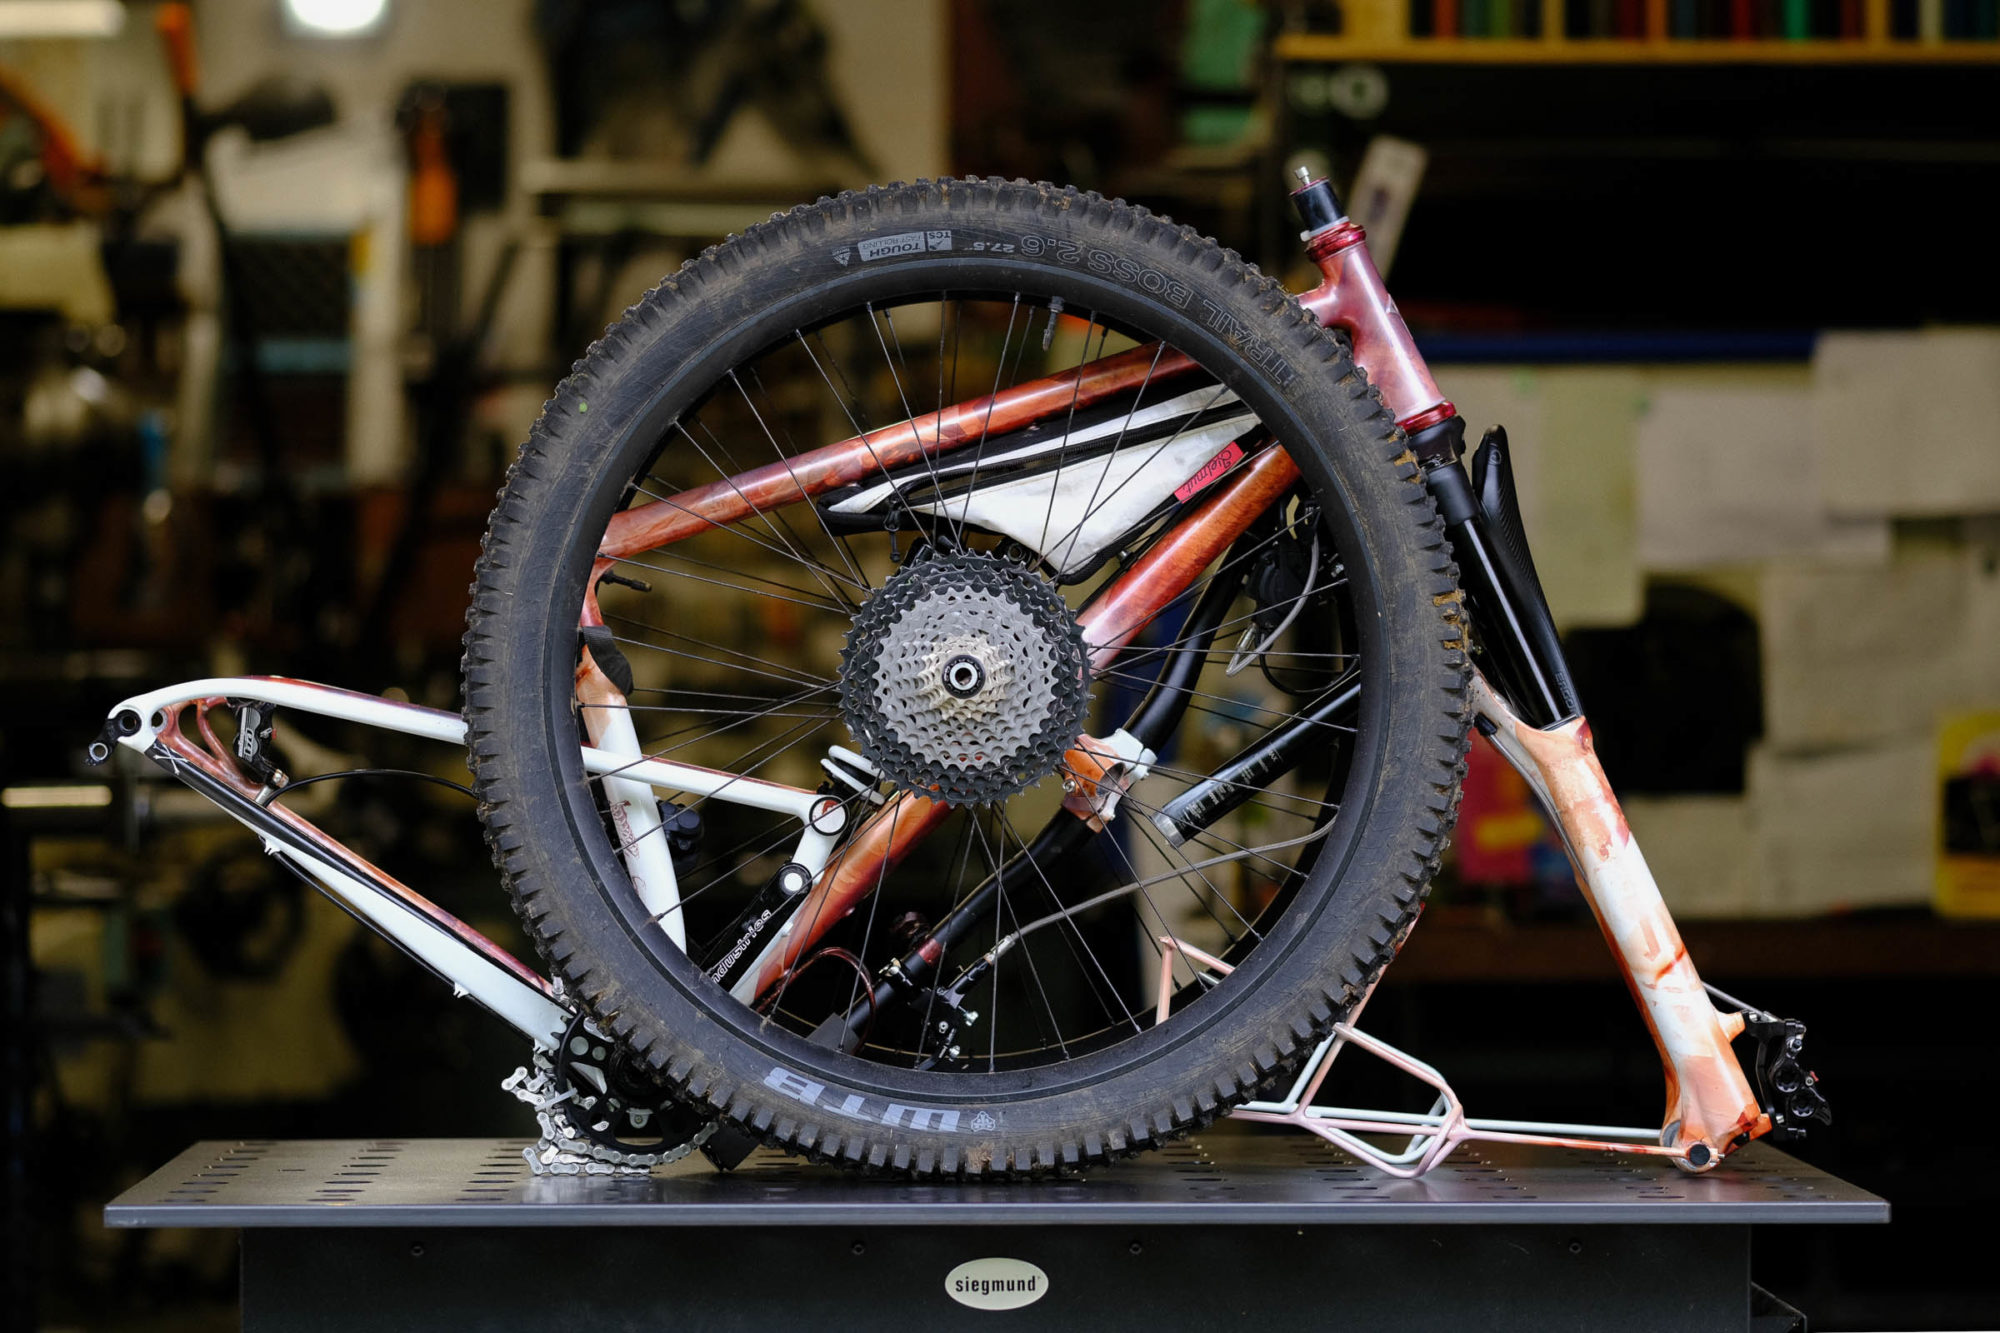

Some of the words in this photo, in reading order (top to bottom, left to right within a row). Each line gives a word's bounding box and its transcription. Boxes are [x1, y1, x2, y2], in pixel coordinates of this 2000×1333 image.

[862, 238, 898, 249] ROLLING
[869, 242, 921, 257] TOUGH
[928, 231, 951, 240] TCS
[1021, 235, 1083, 263] 2.6
[1087, 249, 1194, 309] BOSS
[1202, 299, 1289, 384] TRAIL
[711, 909, 771, 984] ndustries
[763, 1066, 960, 1132] WTB
[955, 1275, 1036, 1296] siegmund
